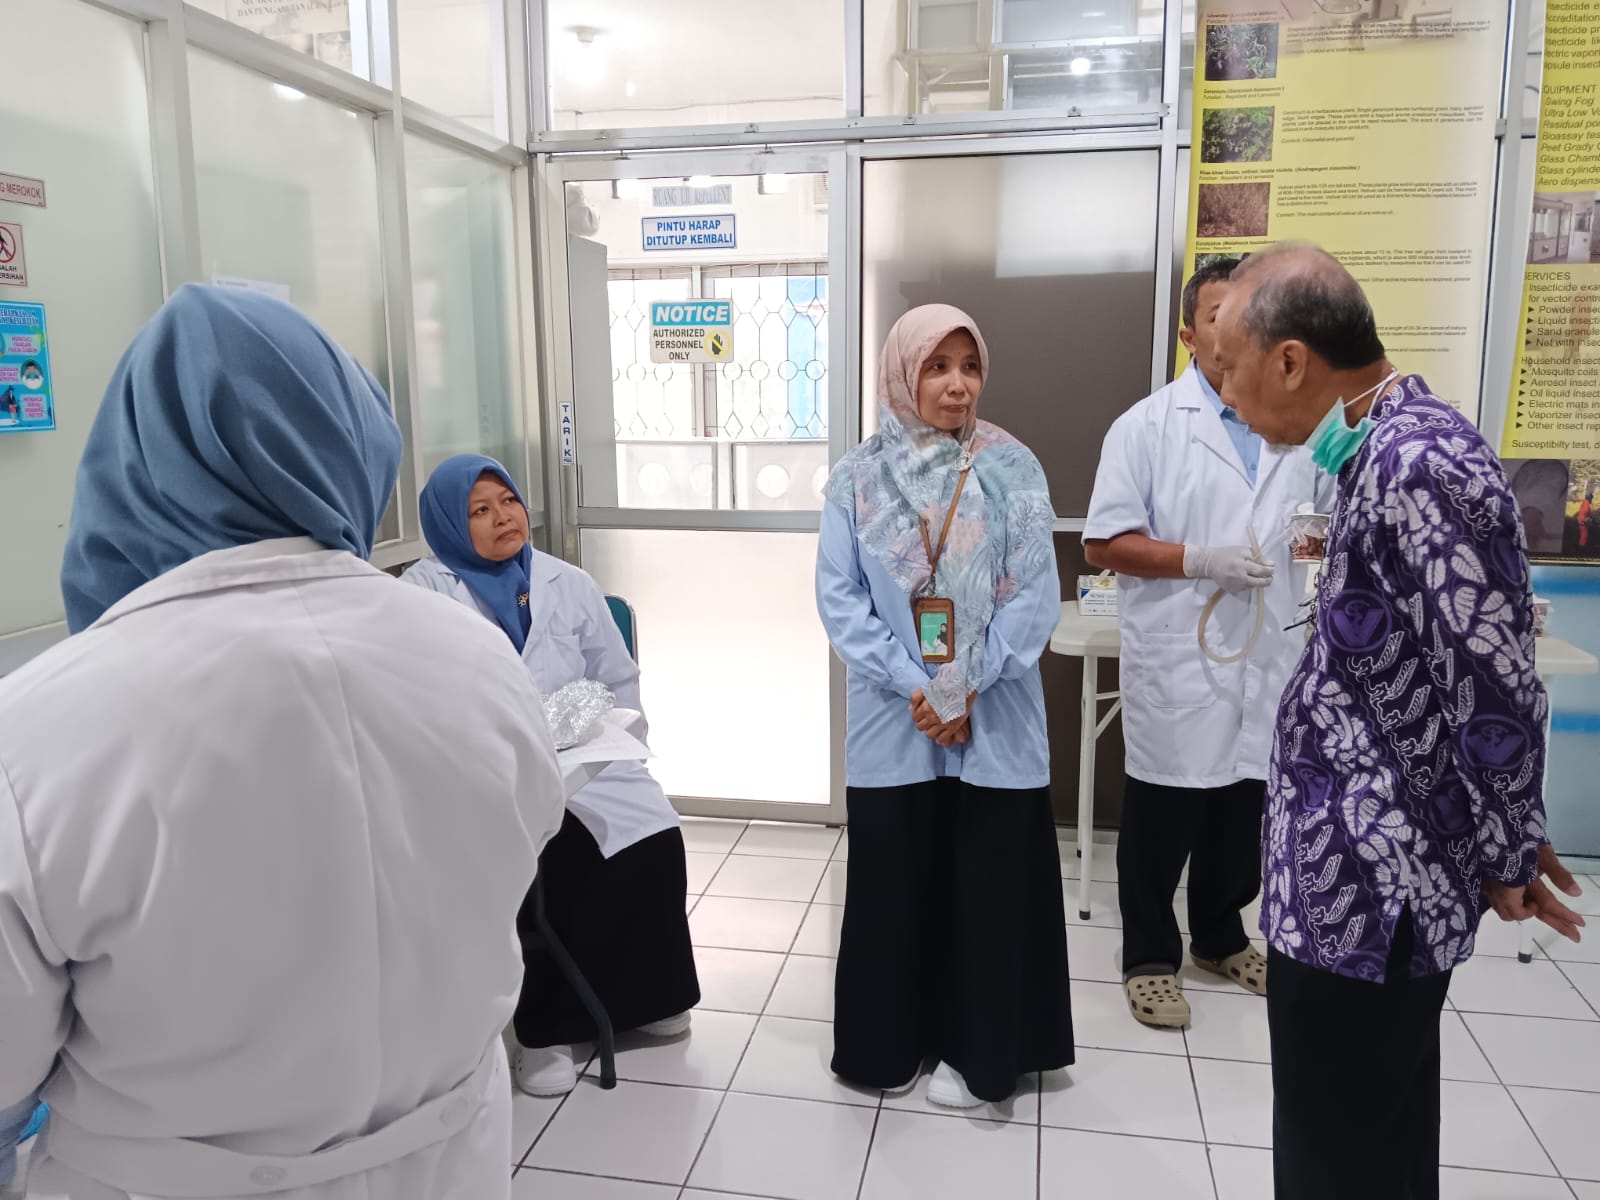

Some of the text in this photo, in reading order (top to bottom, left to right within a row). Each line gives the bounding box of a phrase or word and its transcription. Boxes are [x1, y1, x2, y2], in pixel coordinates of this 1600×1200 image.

[1545, 96, 1594, 107] Swing Fog
[1544, 108, 1565, 117] Ultra
[1567, 107, 1588, 117] Low
[1543, 119, 1583, 128] Residual
[1543, 131, 1583, 141] Bioassay
[1564, 142, 1594, 152] Grady
[1540, 154, 1565, 163] Glass
[1539, 165, 1563, 174] Glass
[1538, 176, 1559, 185] Aero
[7, 182, 41, 198] MEROKOK
[657, 220, 721, 232] PINTU HARAP
[647, 233, 732, 246] DITUTUP KEMBALI
[1529, 283, 1577, 292] Insecticide
[1528, 294, 1540, 302] for
[1543, 294, 1572, 303] vector
[656, 305, 729, 322] NOTICE
[1539, 305, 1574, 314] Powder
[1538, 316, 1567, 325] Liquid
[653, 329, 705, 338] AUTHORIZED
[1537, 327, 1562, 336] Sand
[655, 340, 704, 349] PERSONNEL
[1537, 338, 1554, 347] Net
[1556, 338, 1575, 347] with
[668, 352, 690, 360] ONLY
[1521, 356, 1571, 365] Household
[1532, 367, 1598, 377] Mosquito coils
[1530, 378, 1597, 387] Aerosol insect
[1530, 389, 1543, 398] Oil
[1546, 389, 1570, 399] liquid
[1529, 399, 1564, 408] Electric
[1566, 400, 1589, 408] mats
[1528, 410, 1572, 420] Vaporizer
[1527, 421, 1554, 430] Other
[1556, 421, 1583, 430] insect
[562, 405, 571, 456] TARIK
